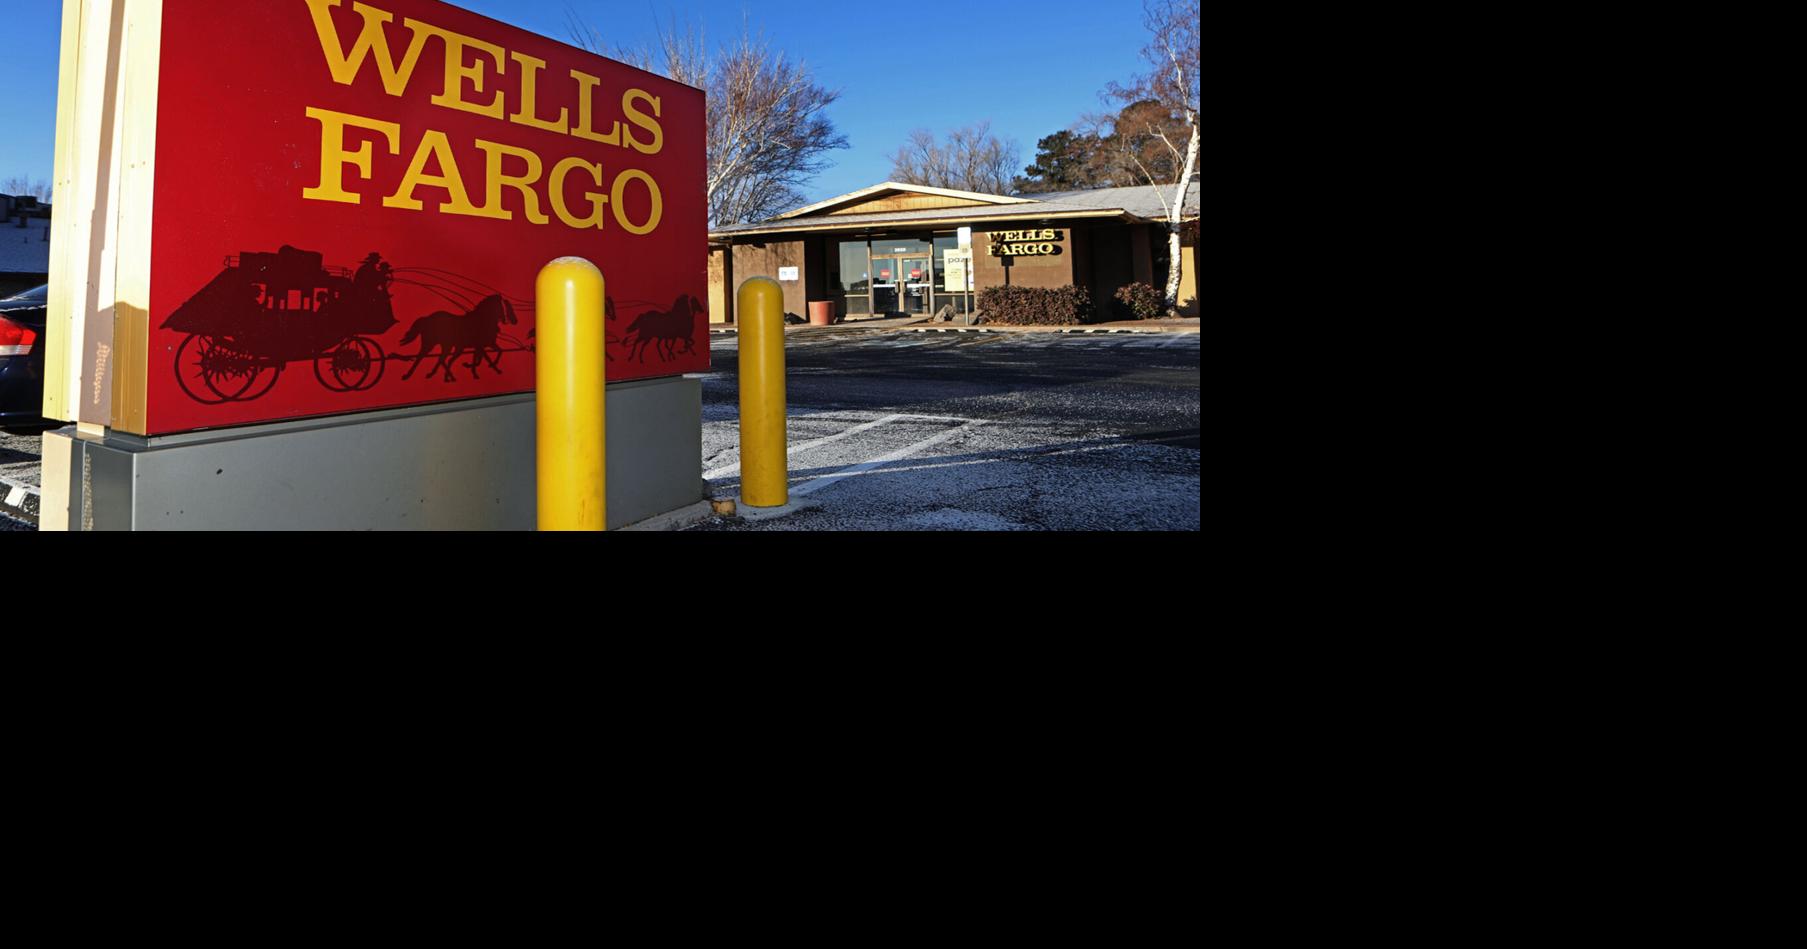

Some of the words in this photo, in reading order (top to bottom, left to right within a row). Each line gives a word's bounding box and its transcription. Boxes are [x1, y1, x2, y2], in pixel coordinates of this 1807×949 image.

[305, 0, 663, 154] WELLS
[303, 106, 663, 235] FARGO
[985, 228, 1056, 242] WELLS
